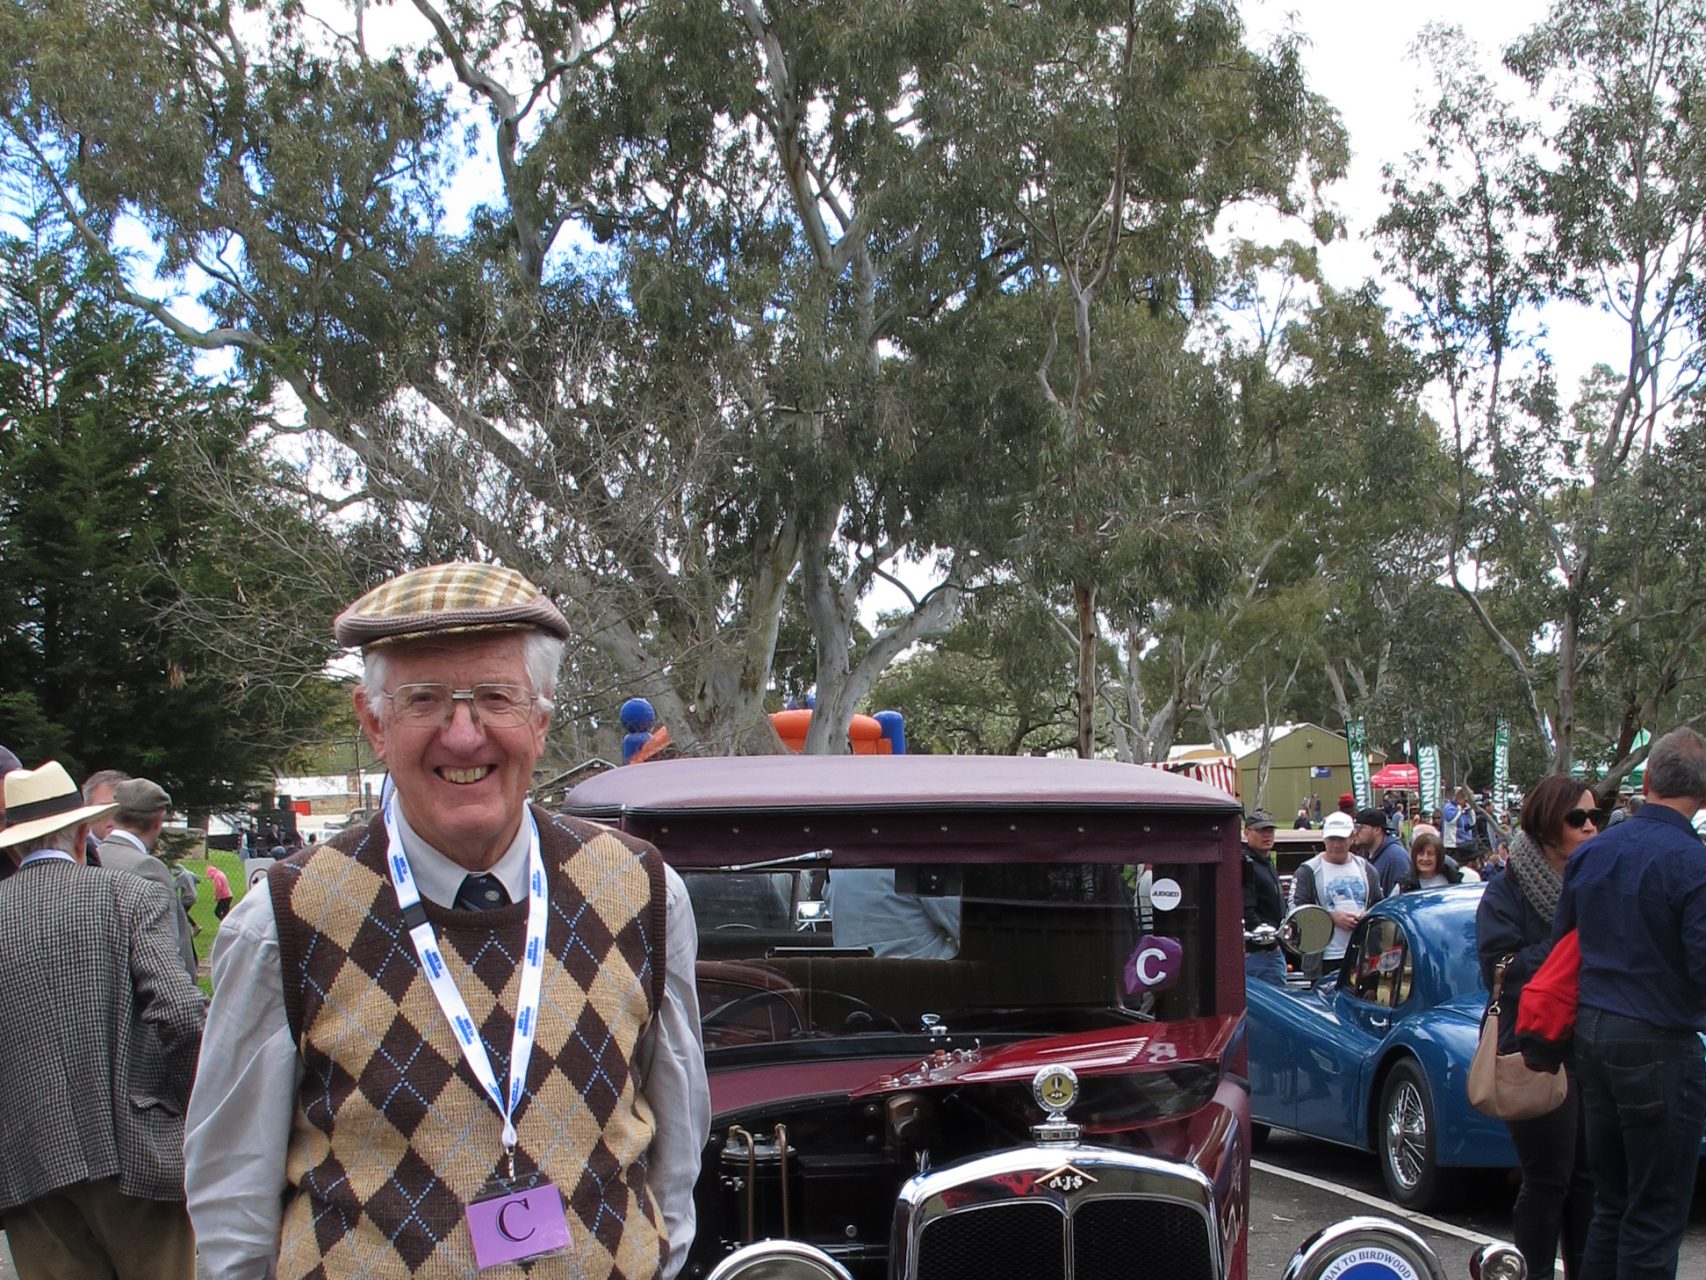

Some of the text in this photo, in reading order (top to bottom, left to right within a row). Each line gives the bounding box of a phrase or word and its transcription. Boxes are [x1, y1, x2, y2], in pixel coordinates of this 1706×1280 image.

[1419, 746, 1435, 812] ANNONS
[1151, 890, 1180, 898] JUDGED
[1136, 947, 1168, 986] C
[496, 1197, 536, 1242] C
[1341, 1254, 1356, 1266] TO
[1358, 1250, 1411, 1280] BIRDWOOD
